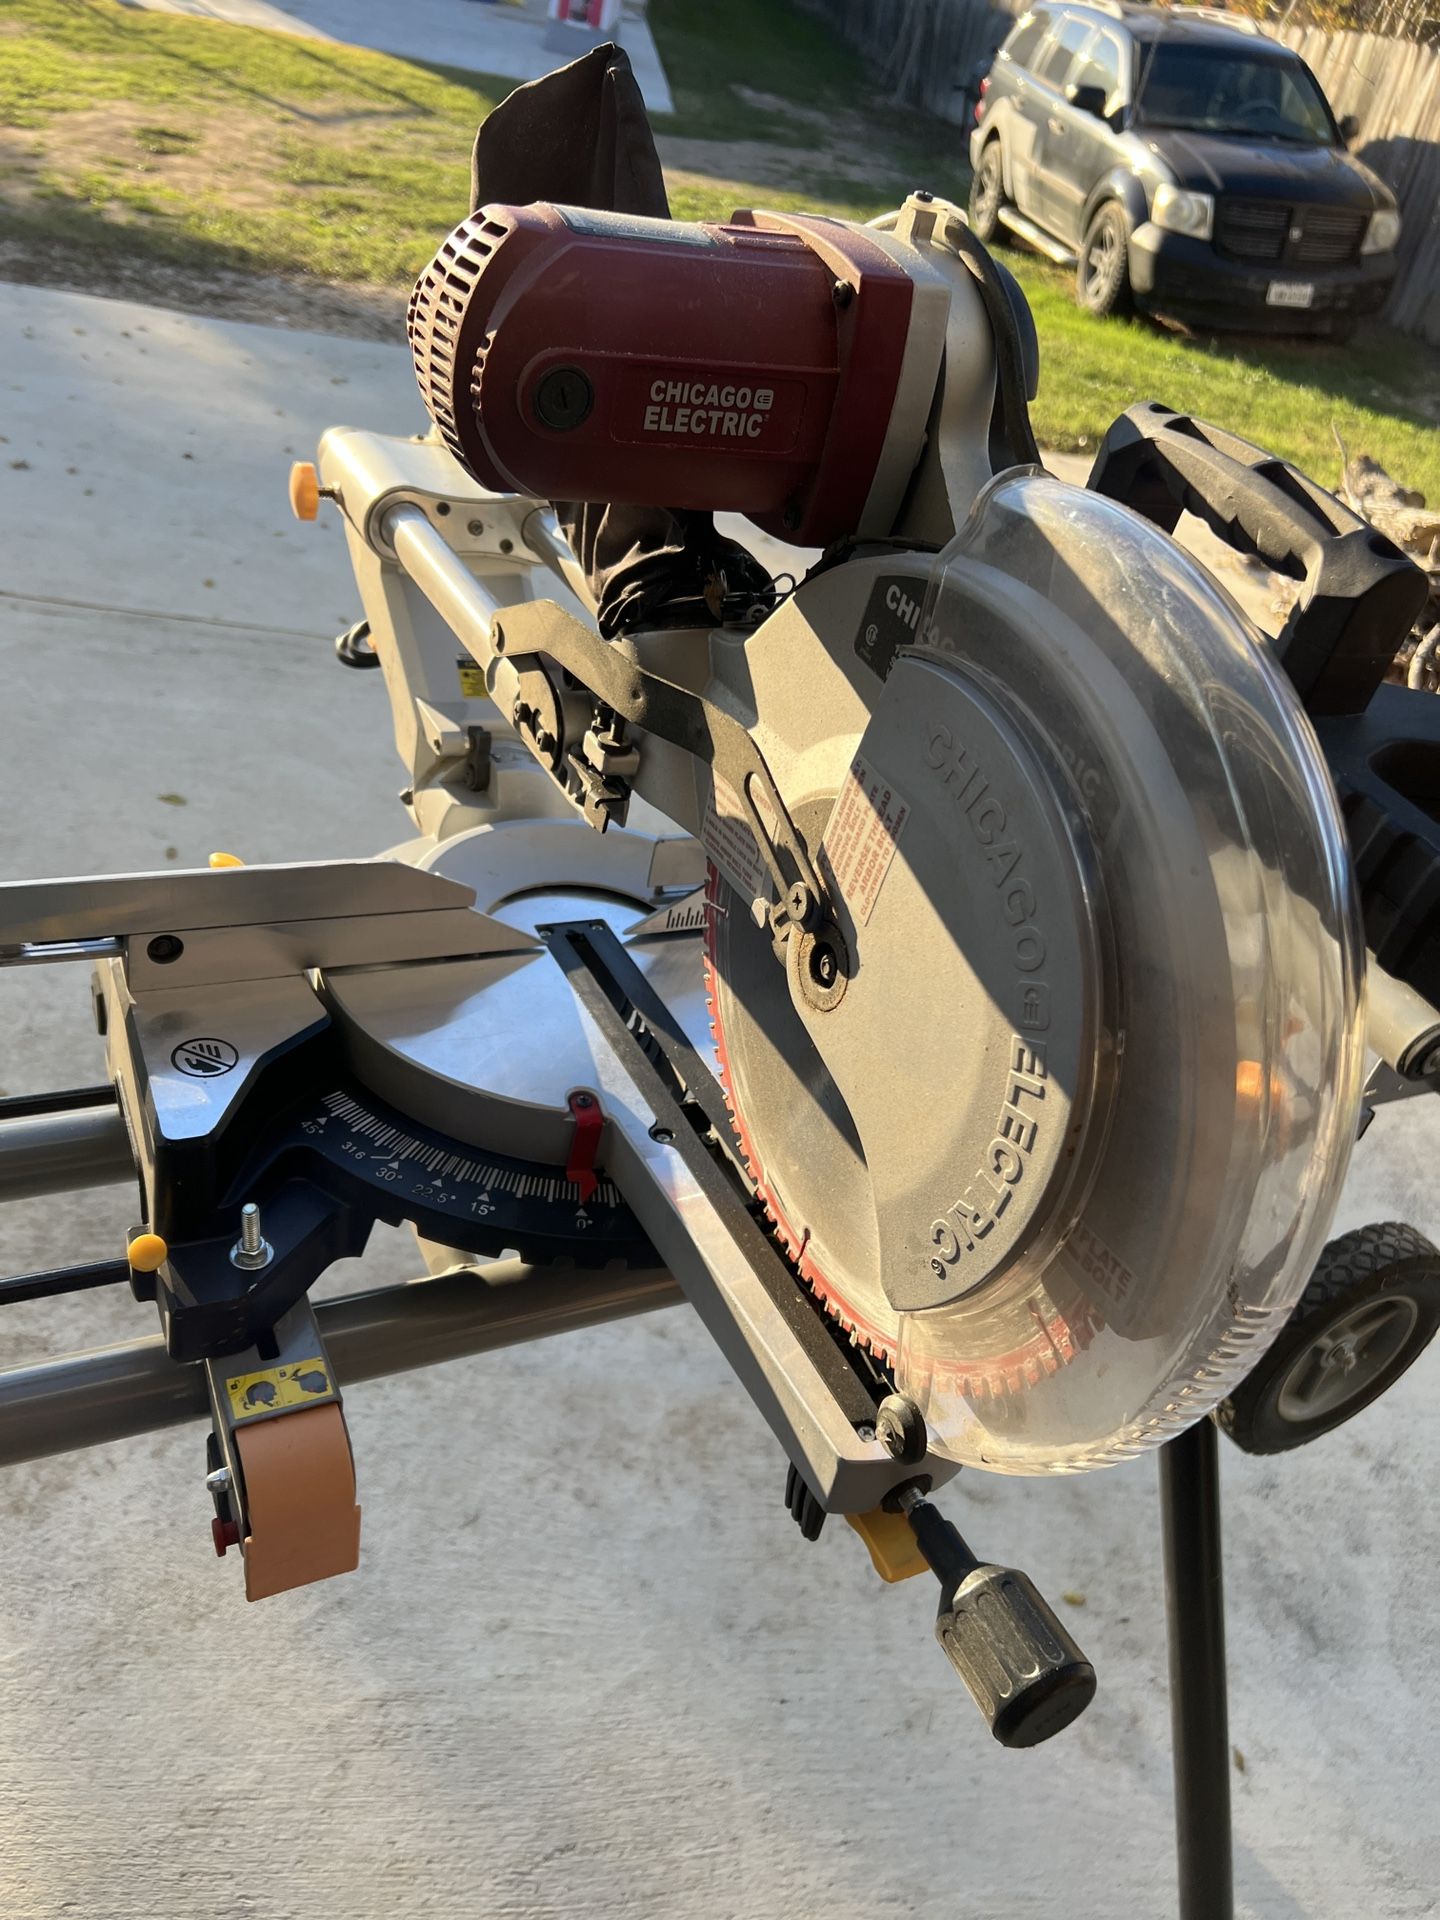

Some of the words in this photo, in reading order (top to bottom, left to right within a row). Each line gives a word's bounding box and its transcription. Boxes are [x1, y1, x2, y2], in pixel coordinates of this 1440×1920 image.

[650, 380, 751, 409] CHICAGO
[643, 405, 763, 438] ELECTRIC
[841, 799, 856, 833] GUARD
[849, 805, 861, 833] BOLT
[846, 842, 872, 900] REVERSE
[868, 790, 891, 842] THREAD
[859, 850, 880, 895] ARBOR
[876, 813, 893, 850] BOLT
[860, 863, 885, 916] CLOCKWISE
[882, 847, 890, 861] TO
[887, 806, 906, 847] LOOSEN
[925, 723, 1047, 973] CHICAGO
[300, 1120, 325, 1135] 45°
[930, 1034, 1048, 1264] ELECTRIC
[375, 1167, 403, 1181] 30°
[411, 1184, 456, 1203] 22.5°
[470, 1201, 496, 1216] 15°
